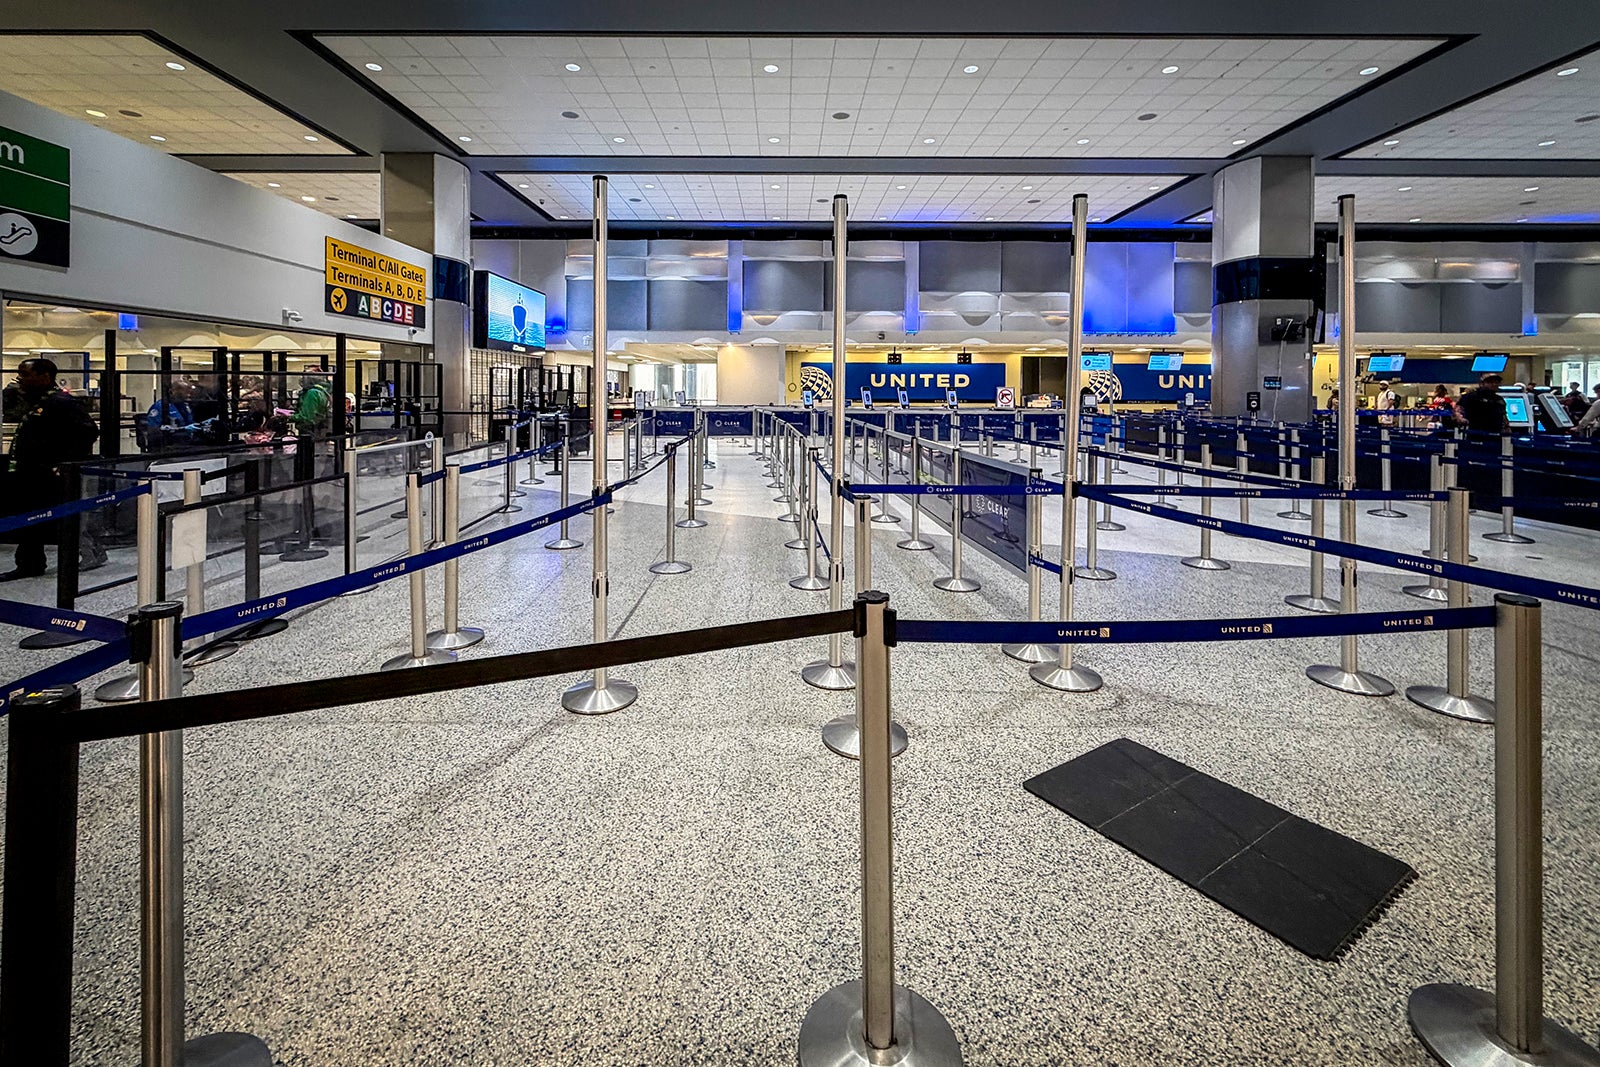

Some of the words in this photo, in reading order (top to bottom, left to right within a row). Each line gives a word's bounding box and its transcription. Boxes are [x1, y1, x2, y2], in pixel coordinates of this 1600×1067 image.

[331, 243, 376, 269] Terminal
[378, 258, 399, 276] C/All
[400, 265, 423, 283] Gates
[331, 266, 383, 292] Terminals
[385, 281, 395, 297] A,
[396, 284, 405, 299] B,
[407, 286, 416, 301] D,
[417, 289, 423, 302] E
[870, 373, 970, 388] UNITED
[1158, 374, 1211, 389] UNI
[987, 501, 1010, 519] CLEAR
[1197, 518, 1217, 526] UNITED
[463, 540, 483, 549] UNITED
[1283, 535, 1308, 545] UNITED
[1397, 558, 1432, 570] UNITED
[373, 565, 399, 578] UNITED
[237, 602, 275, 617] UNITED
[51, 618, 77, 628] UNITED
[1383, 618, 1422, 627] UNITED
[1057, 629, 1098, 637] UNITED
[1221, 625, 1261, 633] UNITED
